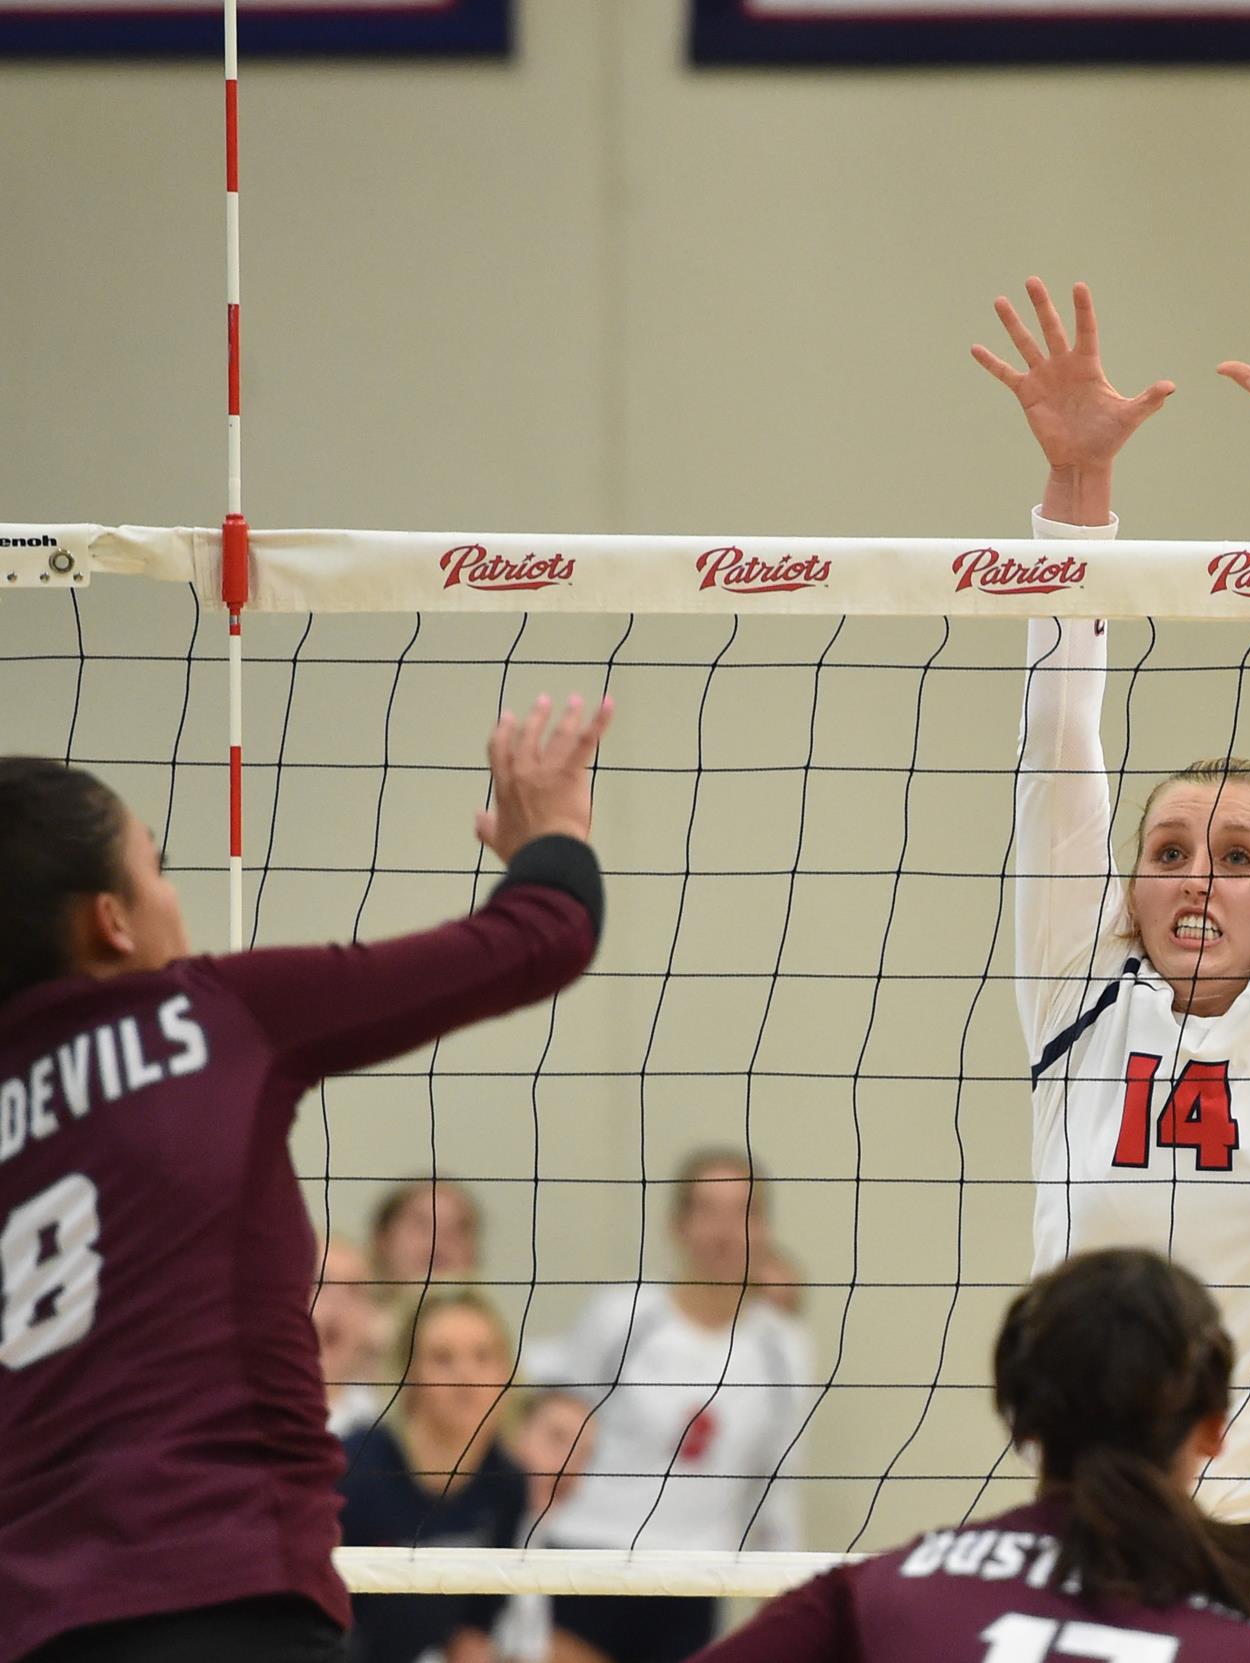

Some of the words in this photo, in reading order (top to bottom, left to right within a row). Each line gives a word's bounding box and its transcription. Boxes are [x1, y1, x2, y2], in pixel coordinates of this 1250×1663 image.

[440, 545, 575, 591] Patriots
[696, 547, 832, 593] Patriots
[952, 550, 1087, 596] Patriots
[0, 995, 209, 1163] DEVILS
[1112, 1052, 1239, 1171] 14
[0, 1173, 103, 1371] 8
